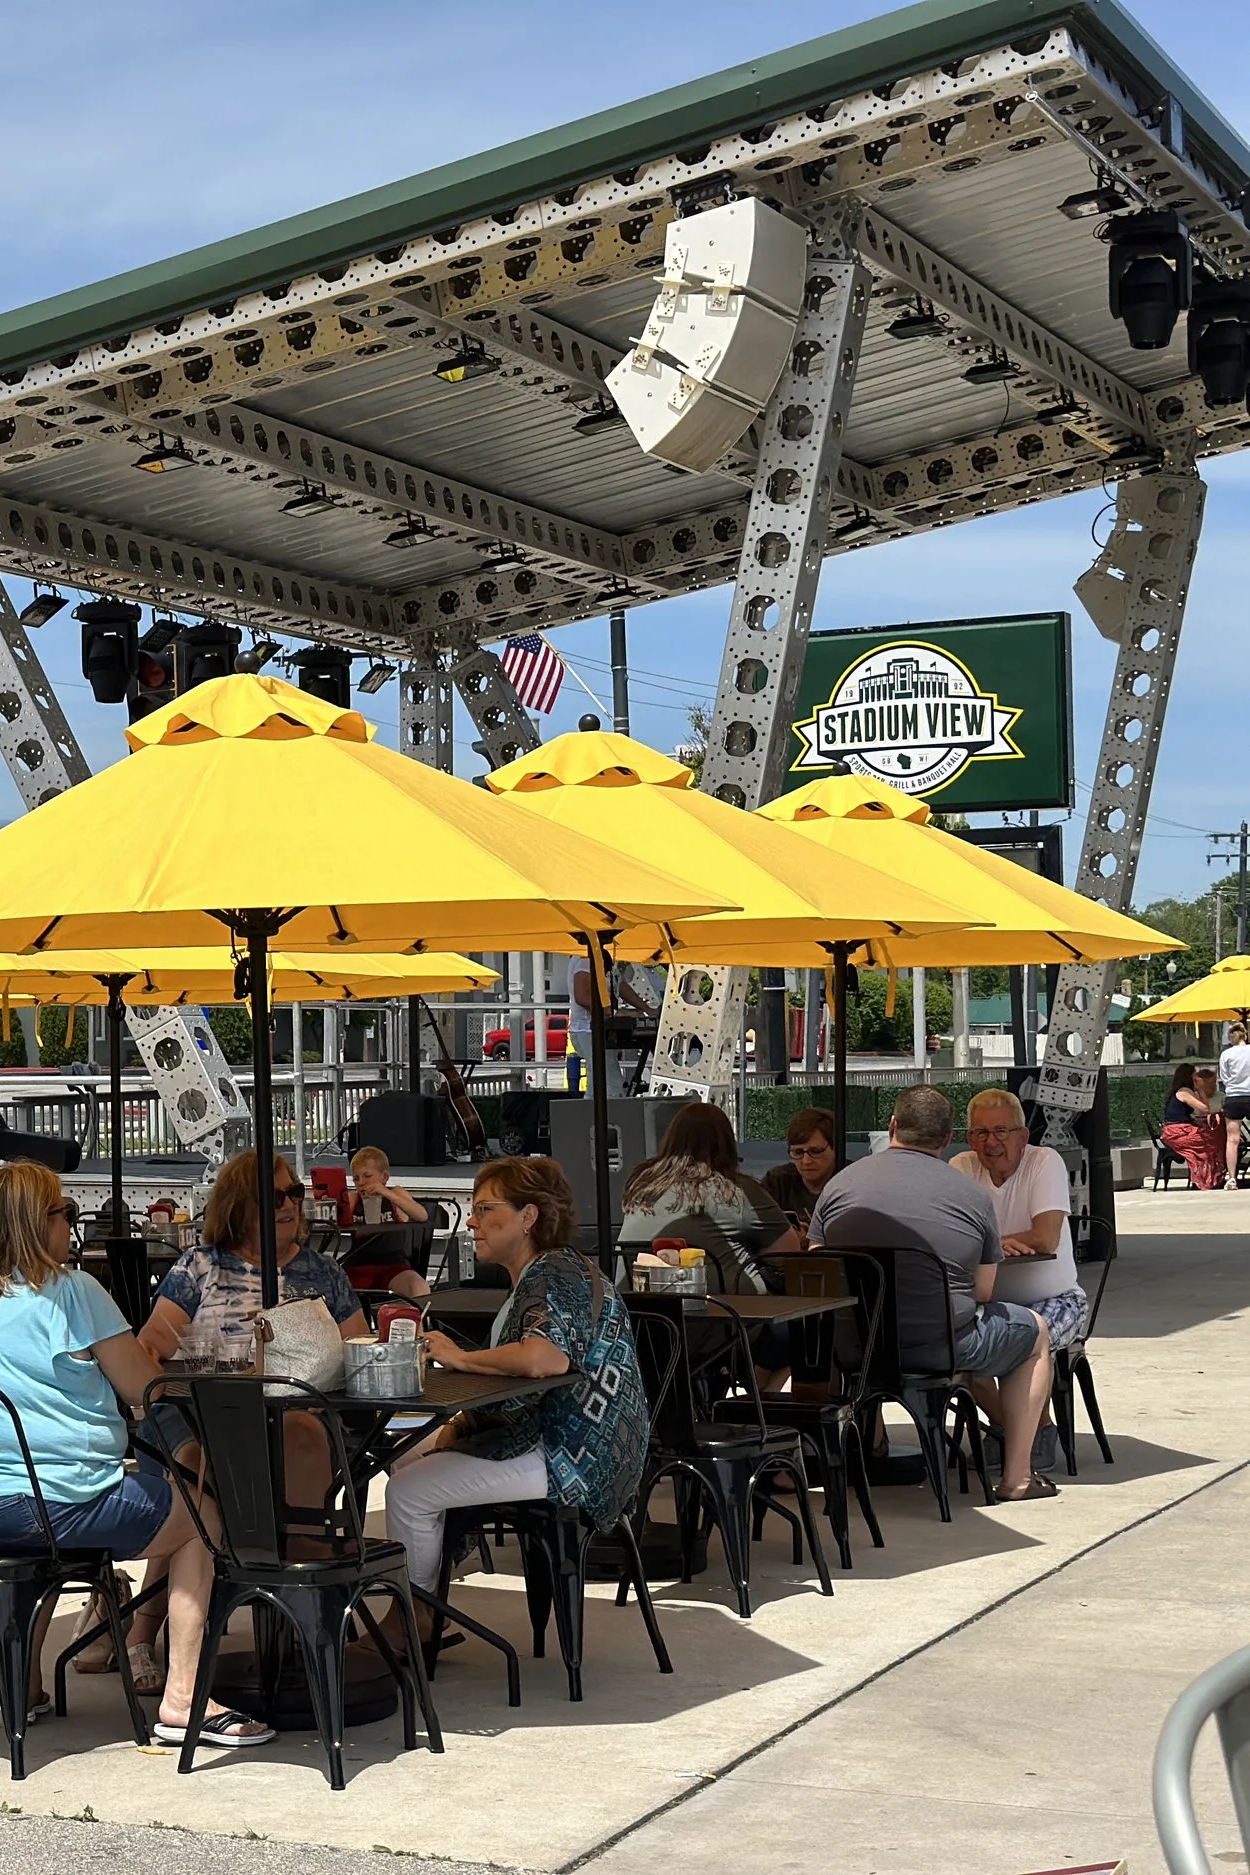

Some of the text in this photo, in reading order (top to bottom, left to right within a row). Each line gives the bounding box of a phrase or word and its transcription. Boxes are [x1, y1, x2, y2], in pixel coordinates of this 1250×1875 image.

[845, 682, 964, 698] 19 92
[824, 702, 986, 745] STADIUM VIEW
[889, 779, 909, 789] GRILL
[917, 766, 948, 787] BANQUET
[948, 751, 962, 768] HALL
